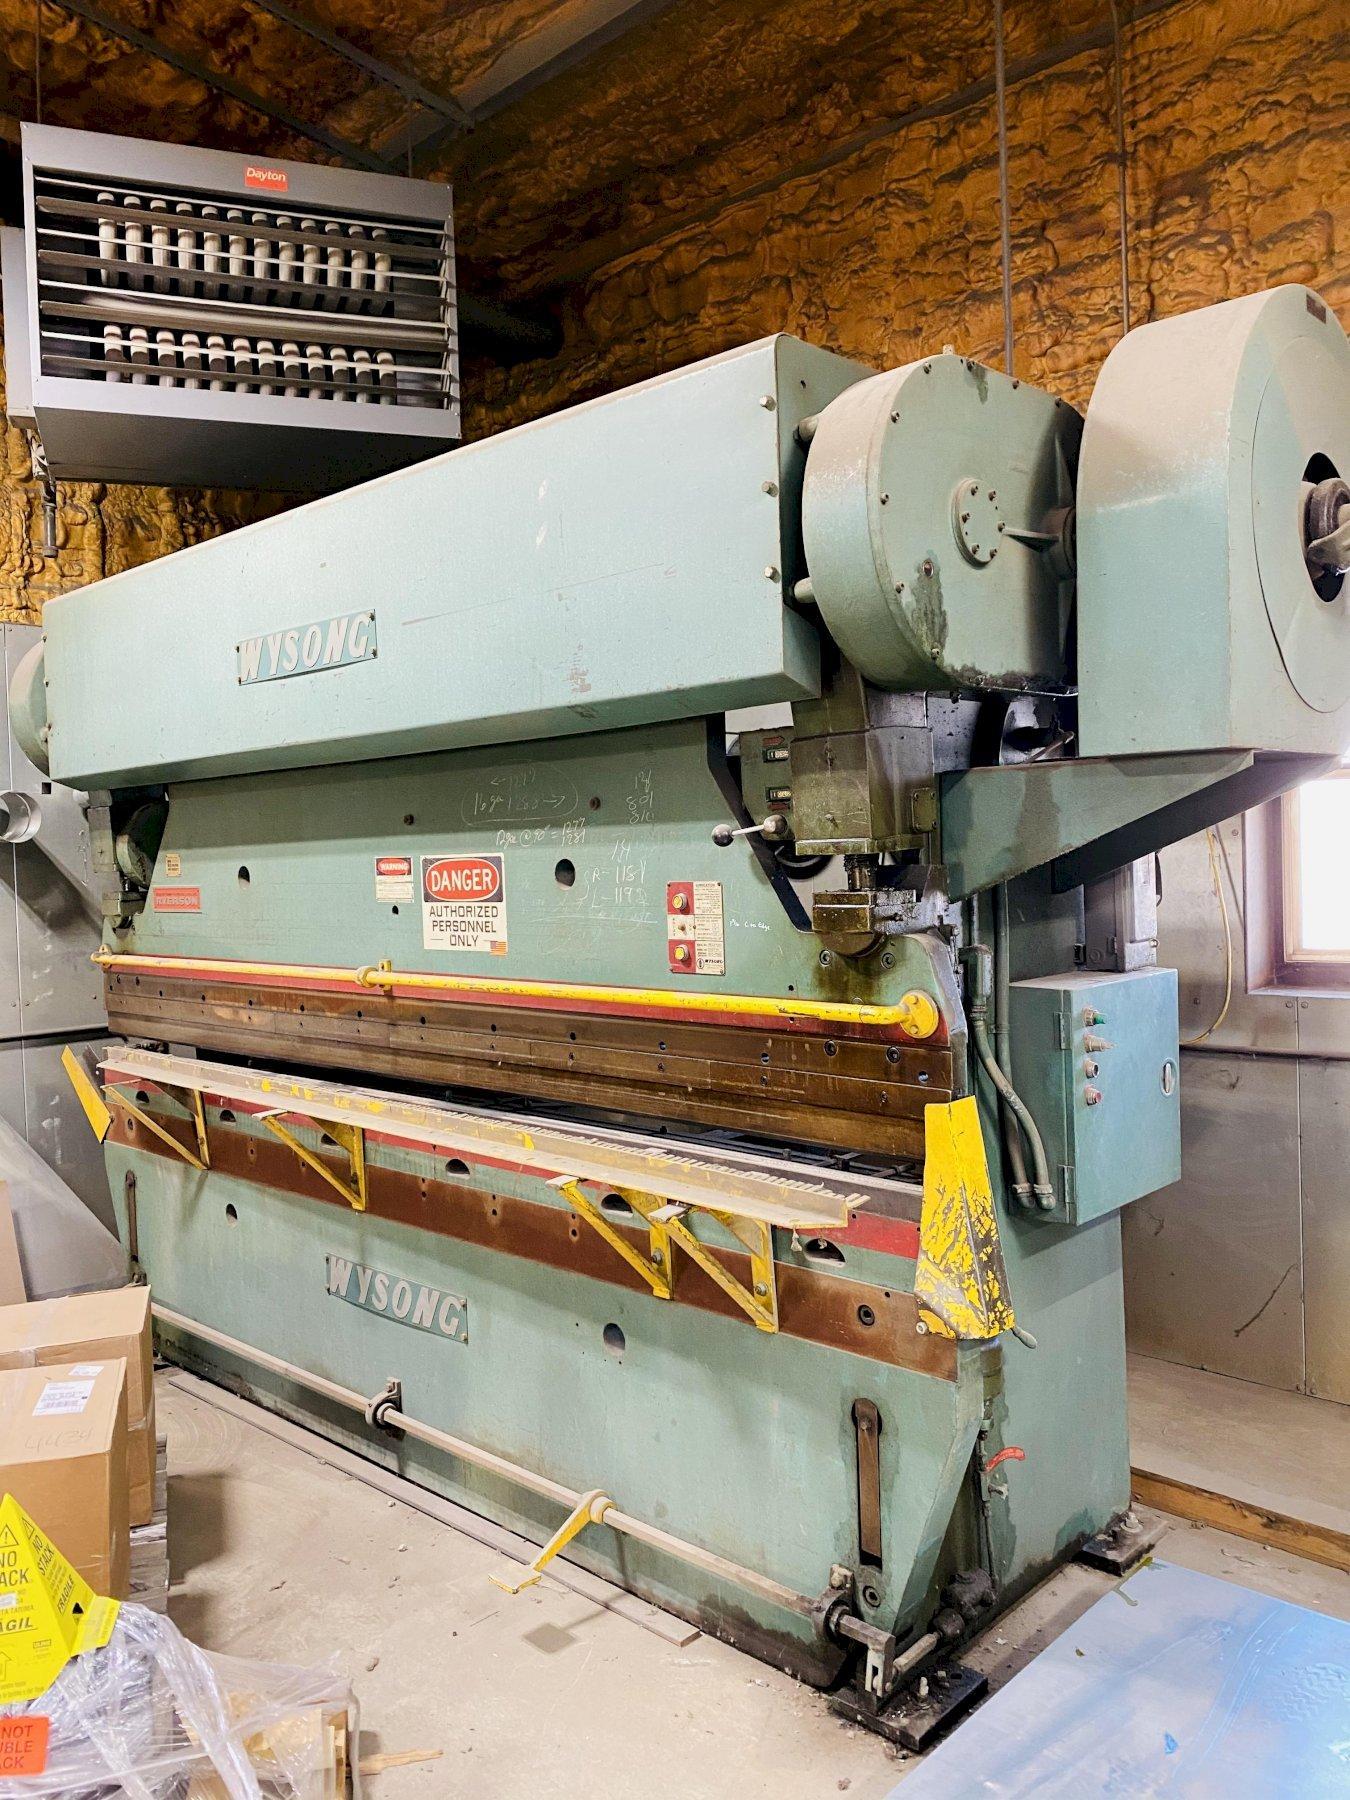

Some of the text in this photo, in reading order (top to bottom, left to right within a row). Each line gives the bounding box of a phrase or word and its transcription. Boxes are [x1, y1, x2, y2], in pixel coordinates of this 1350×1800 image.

[246, 167, 286, 181] Dayton
[240, 613, 370, 682] WYSONG
[380, 863, 409, 871] WARNING
[430, 868, 493, 892] DANGER
[429, 906, 499, 918] AUTHORIZED
[432, 920, 497, 933] PERSONNEL
[449, 935, 479, 947] ONLY
[330, 1256, 463, 1336] WYSONG
[32, 1534, 43, 1553] NO
[37, 1545, 55, 1576] STACK
[0, 1567, 29, 1587] ACK
[1, 1724, 33, 1739] NOT
